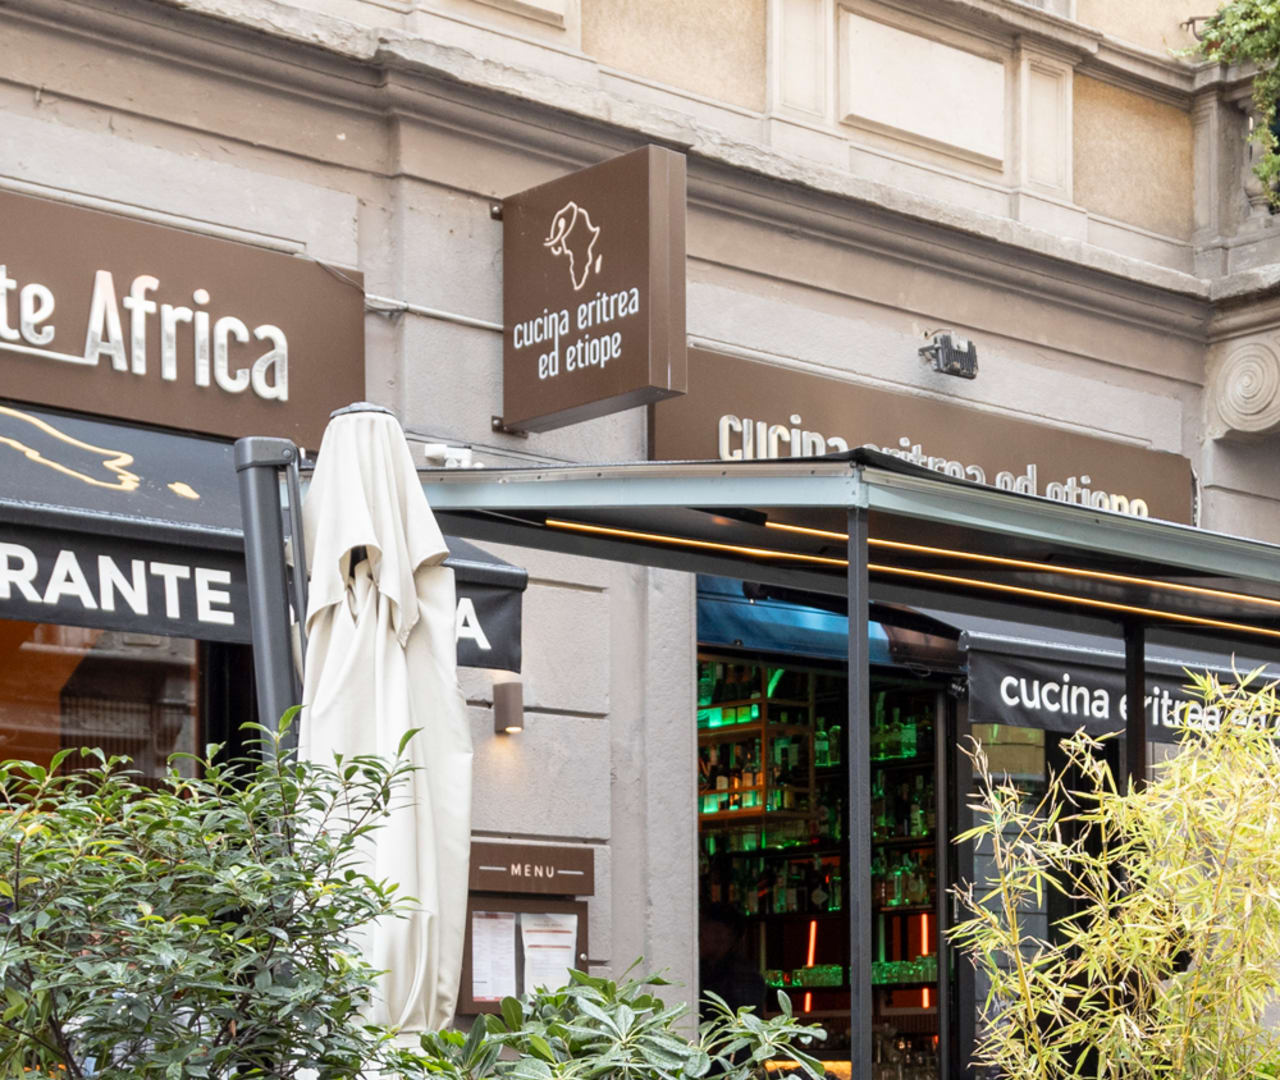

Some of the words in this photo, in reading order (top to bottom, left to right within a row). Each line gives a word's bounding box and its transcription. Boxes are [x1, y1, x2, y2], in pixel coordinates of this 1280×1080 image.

[84, 270, 289, 402] Africa
[513, 308, 569, 349] cucina
[577, 287, 639, 330] eritrea
[538, 342, 559, 379] ed
[566, 332, 621, 371] etiope
[1000, 674, 1109, 719] cucina
[511, 864, 554, 878] MENU
